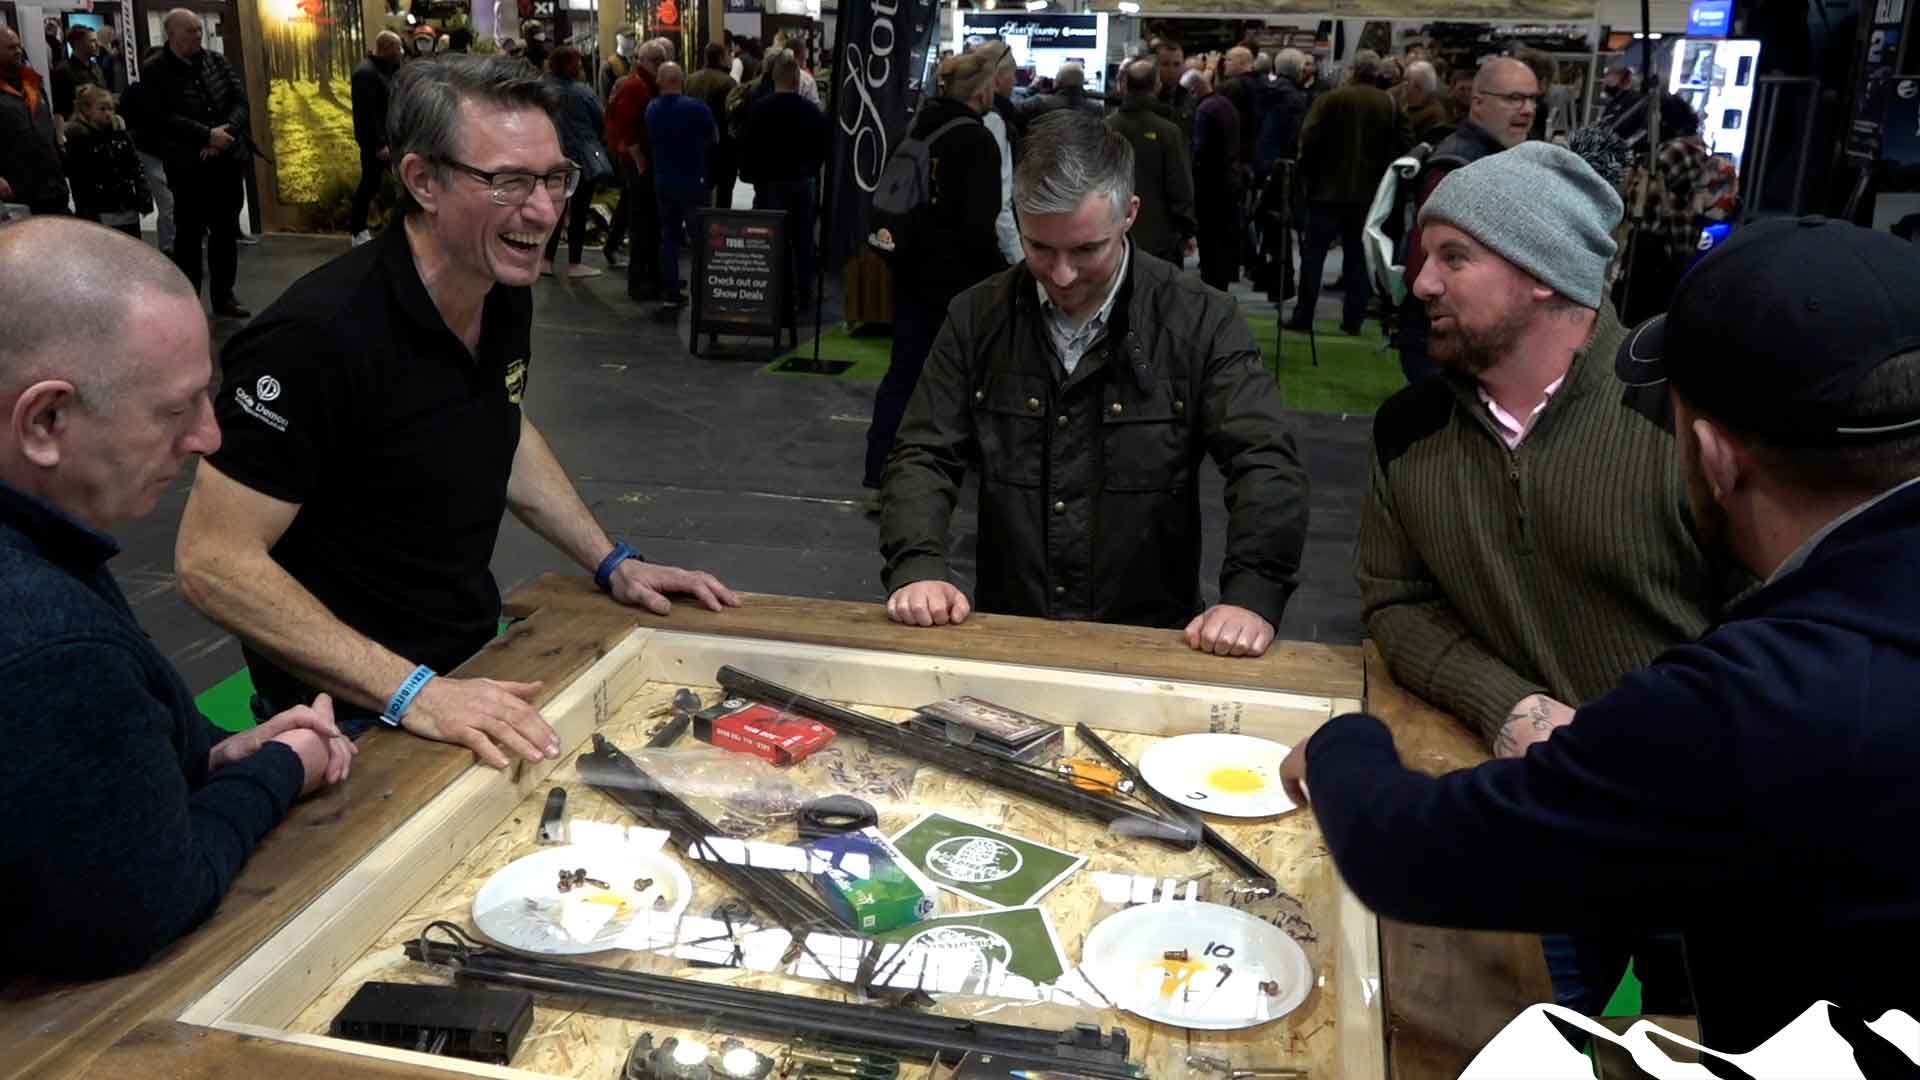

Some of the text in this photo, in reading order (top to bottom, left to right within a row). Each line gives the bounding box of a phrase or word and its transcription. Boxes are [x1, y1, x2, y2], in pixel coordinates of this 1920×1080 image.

[708, 275, 768, 288] Check out our
[712, 287, 764, 301] Show Deals
[1203, 941, 1235, 958] 10
